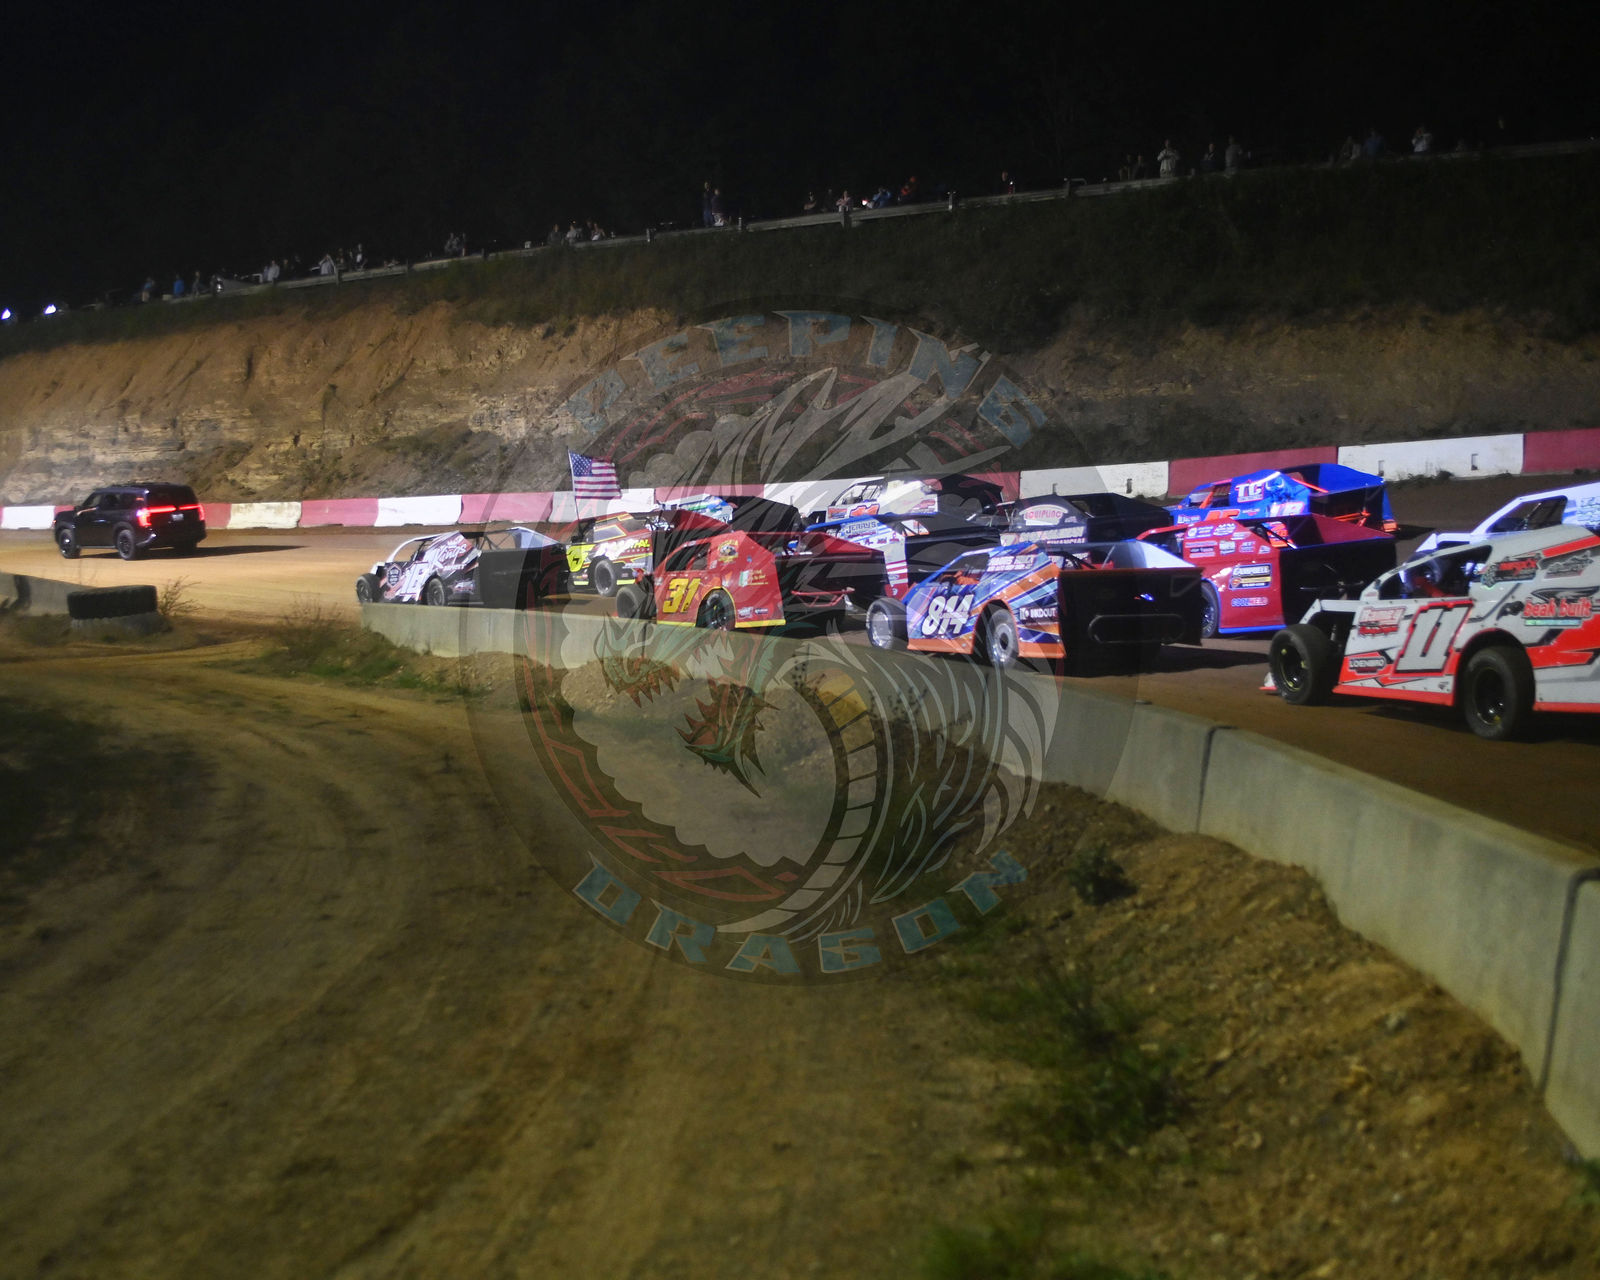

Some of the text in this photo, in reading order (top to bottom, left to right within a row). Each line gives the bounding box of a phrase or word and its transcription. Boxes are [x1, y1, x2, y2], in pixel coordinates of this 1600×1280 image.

[662, 577, 701, 614] 31
[921, 593, 975, 636] 814
[1559, 596, 1593, 617] built
[1394, 603, 1471, 672] 11
